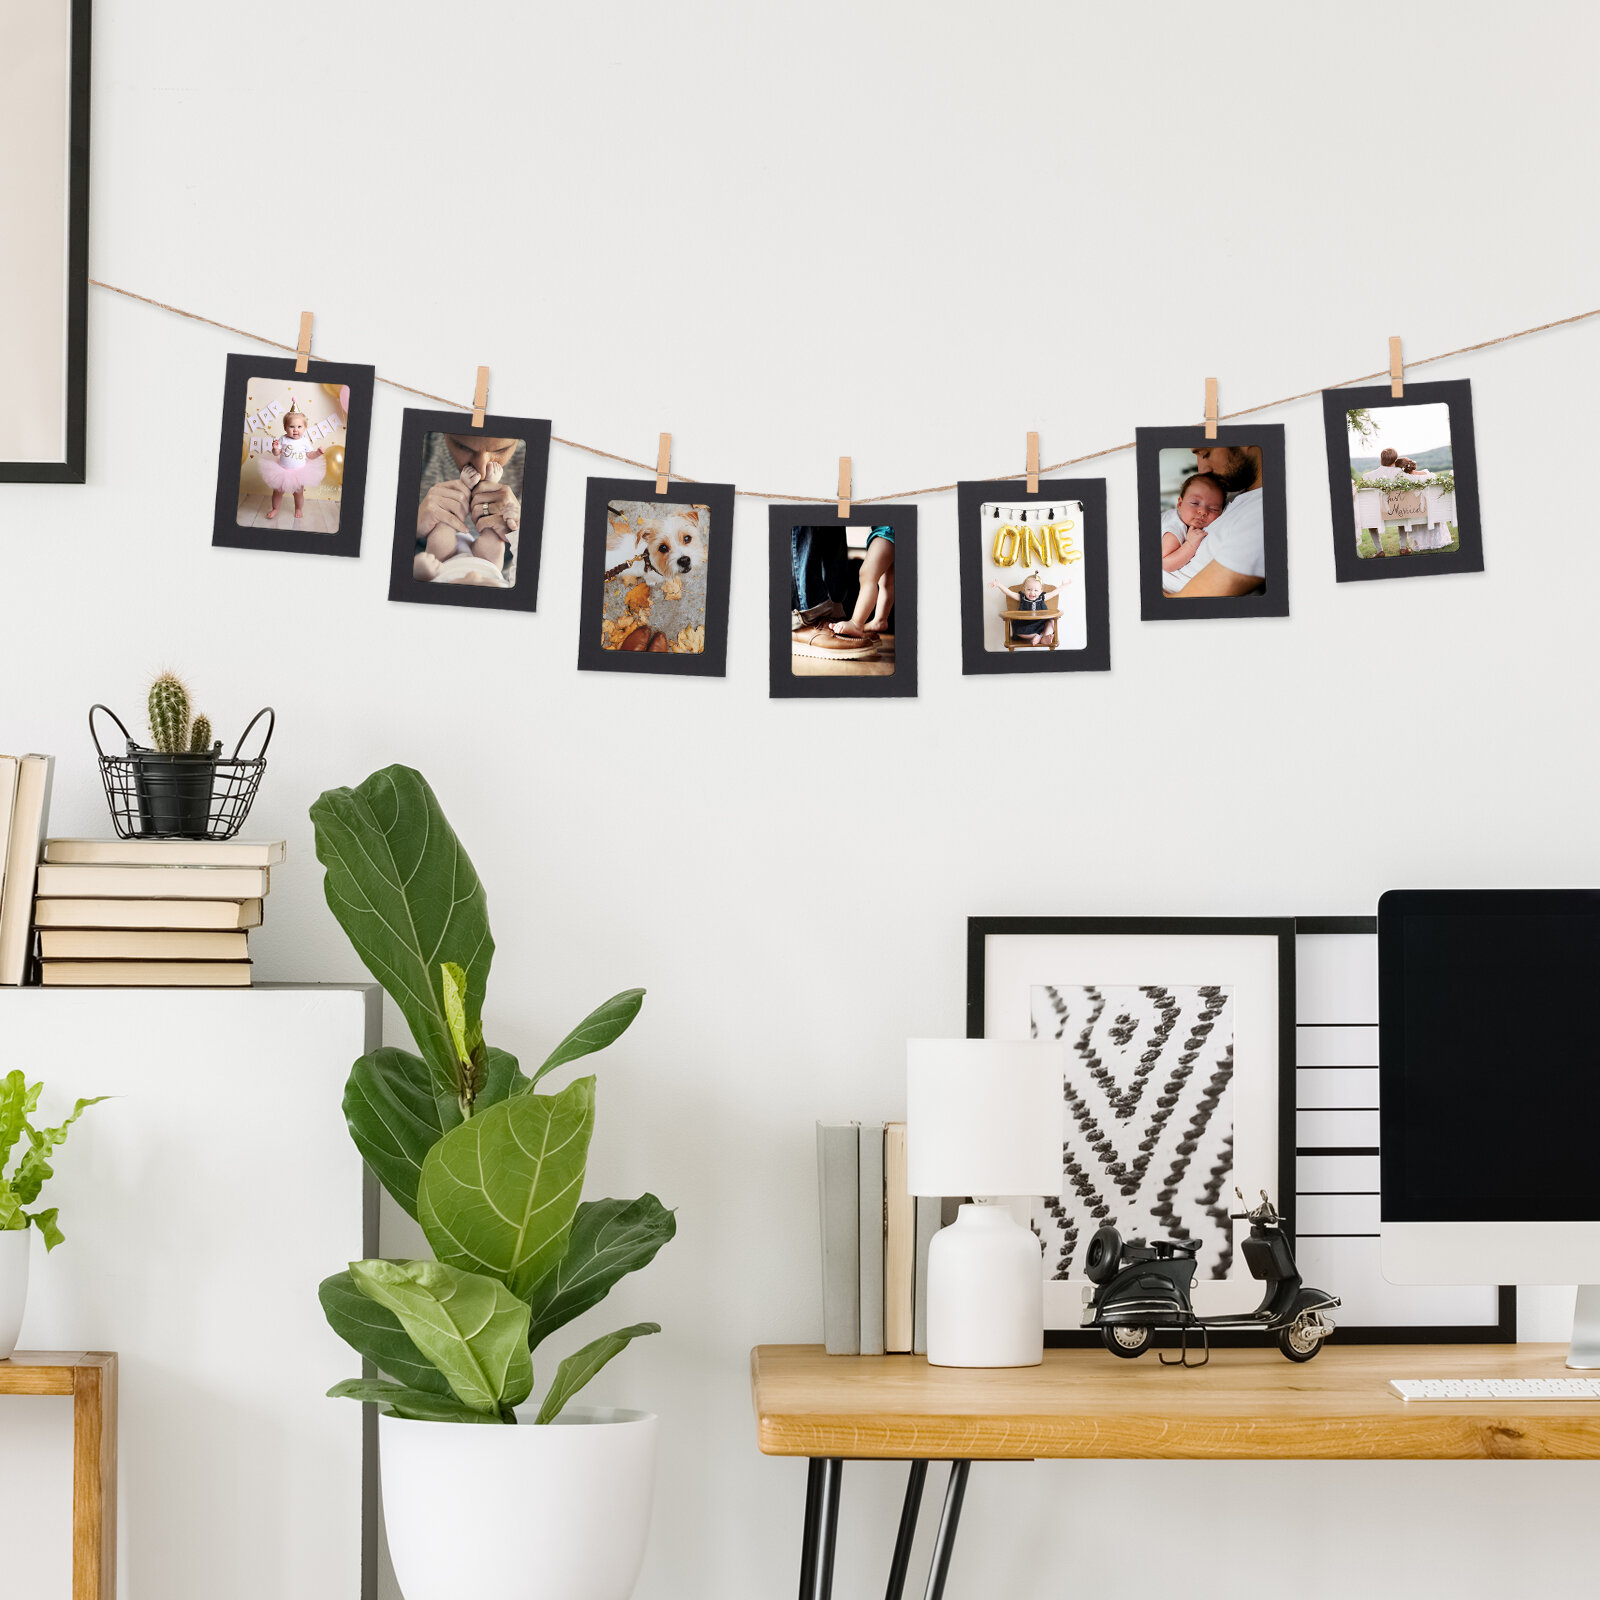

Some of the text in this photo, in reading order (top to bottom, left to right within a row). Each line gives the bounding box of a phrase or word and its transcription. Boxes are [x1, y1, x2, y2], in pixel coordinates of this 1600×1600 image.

[284, 444, 304, 460] One
[1388, 491, 1402, 504] Just
[1388, 504, 1425, 517] Married
[992, 520, 1082, 568] ONE
